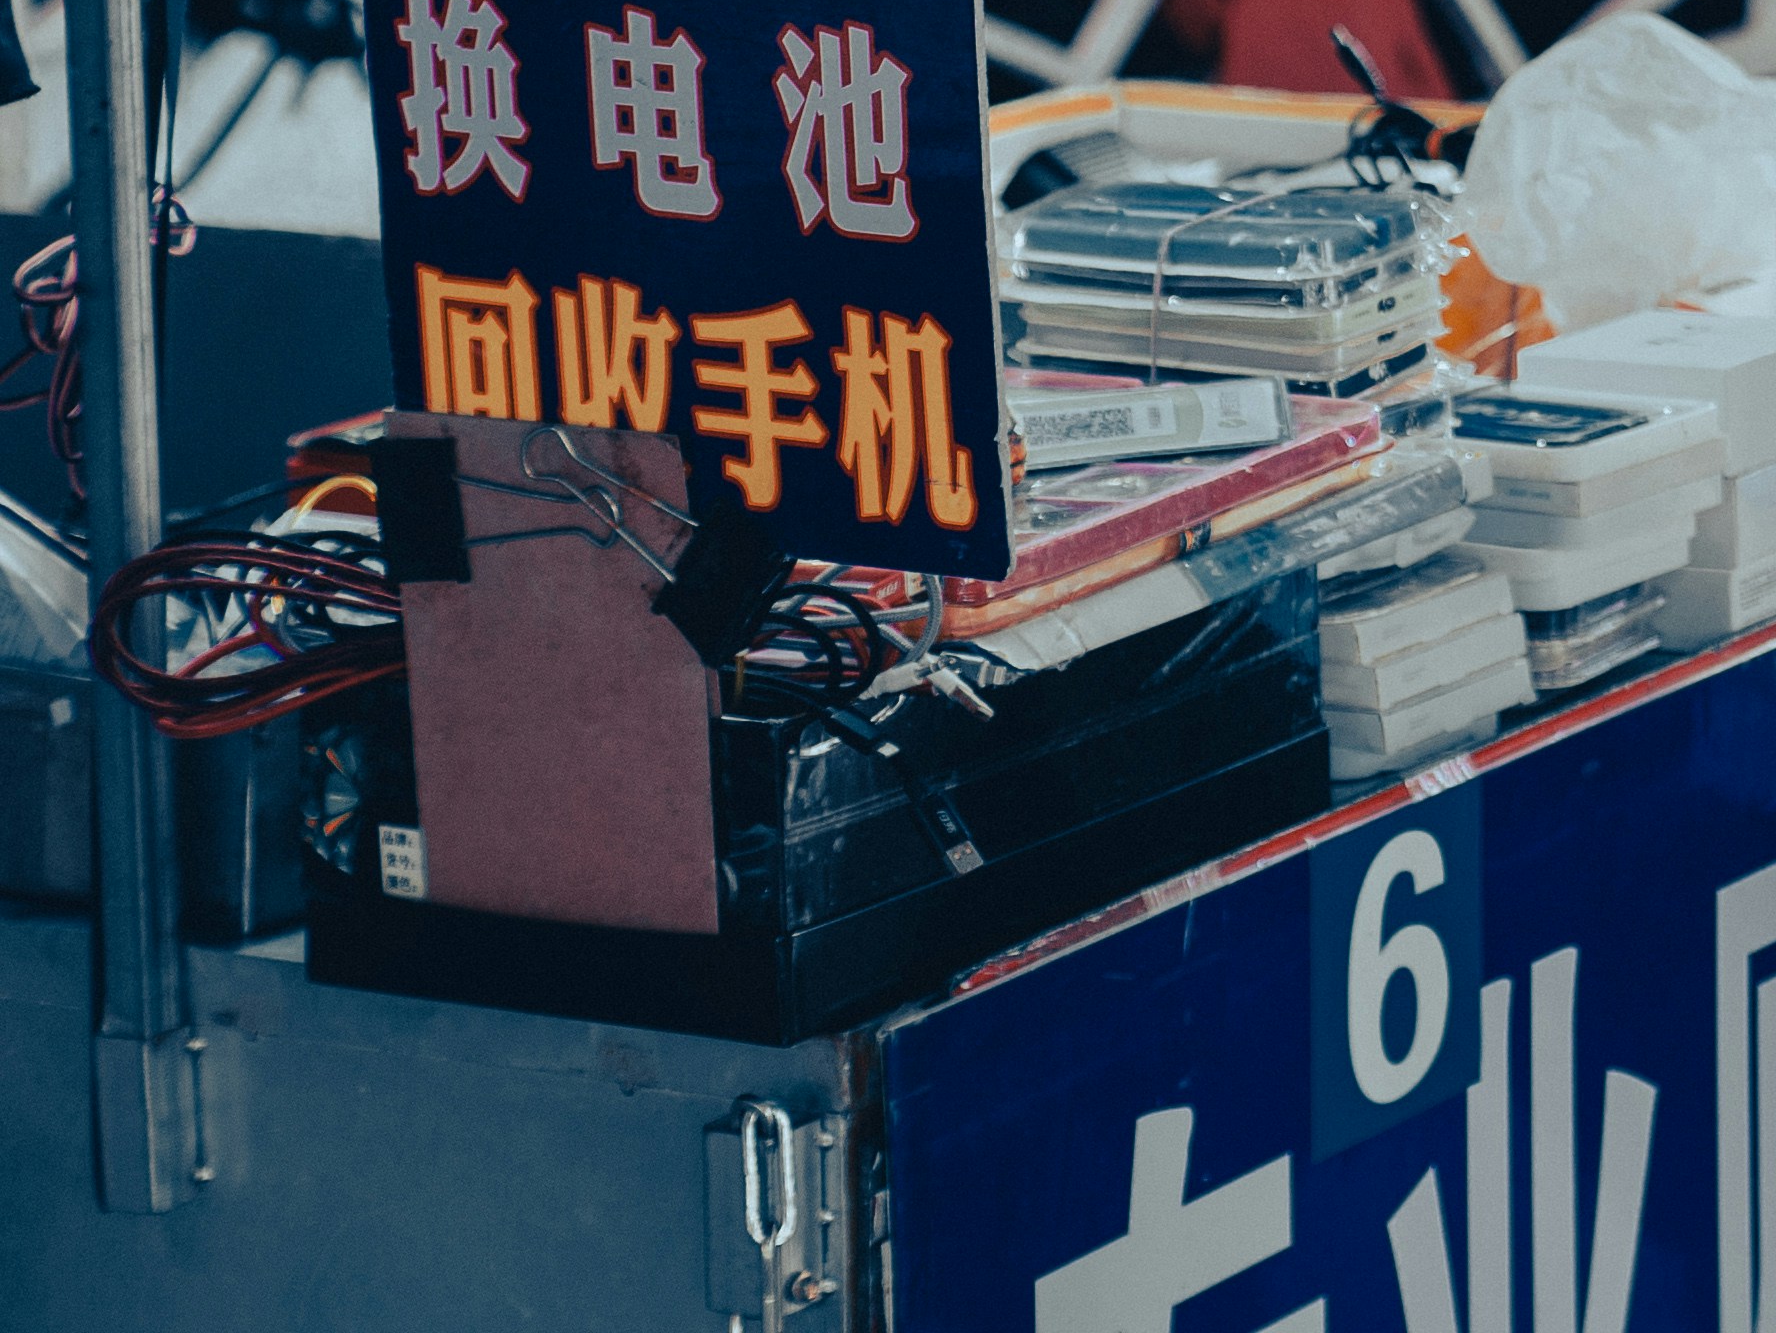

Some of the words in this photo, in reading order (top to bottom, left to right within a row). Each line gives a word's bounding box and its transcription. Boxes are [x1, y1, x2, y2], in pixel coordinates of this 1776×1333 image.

[413, 265, 979, 530] 回收手机
[1347, 830, 1451, 1106] 6
